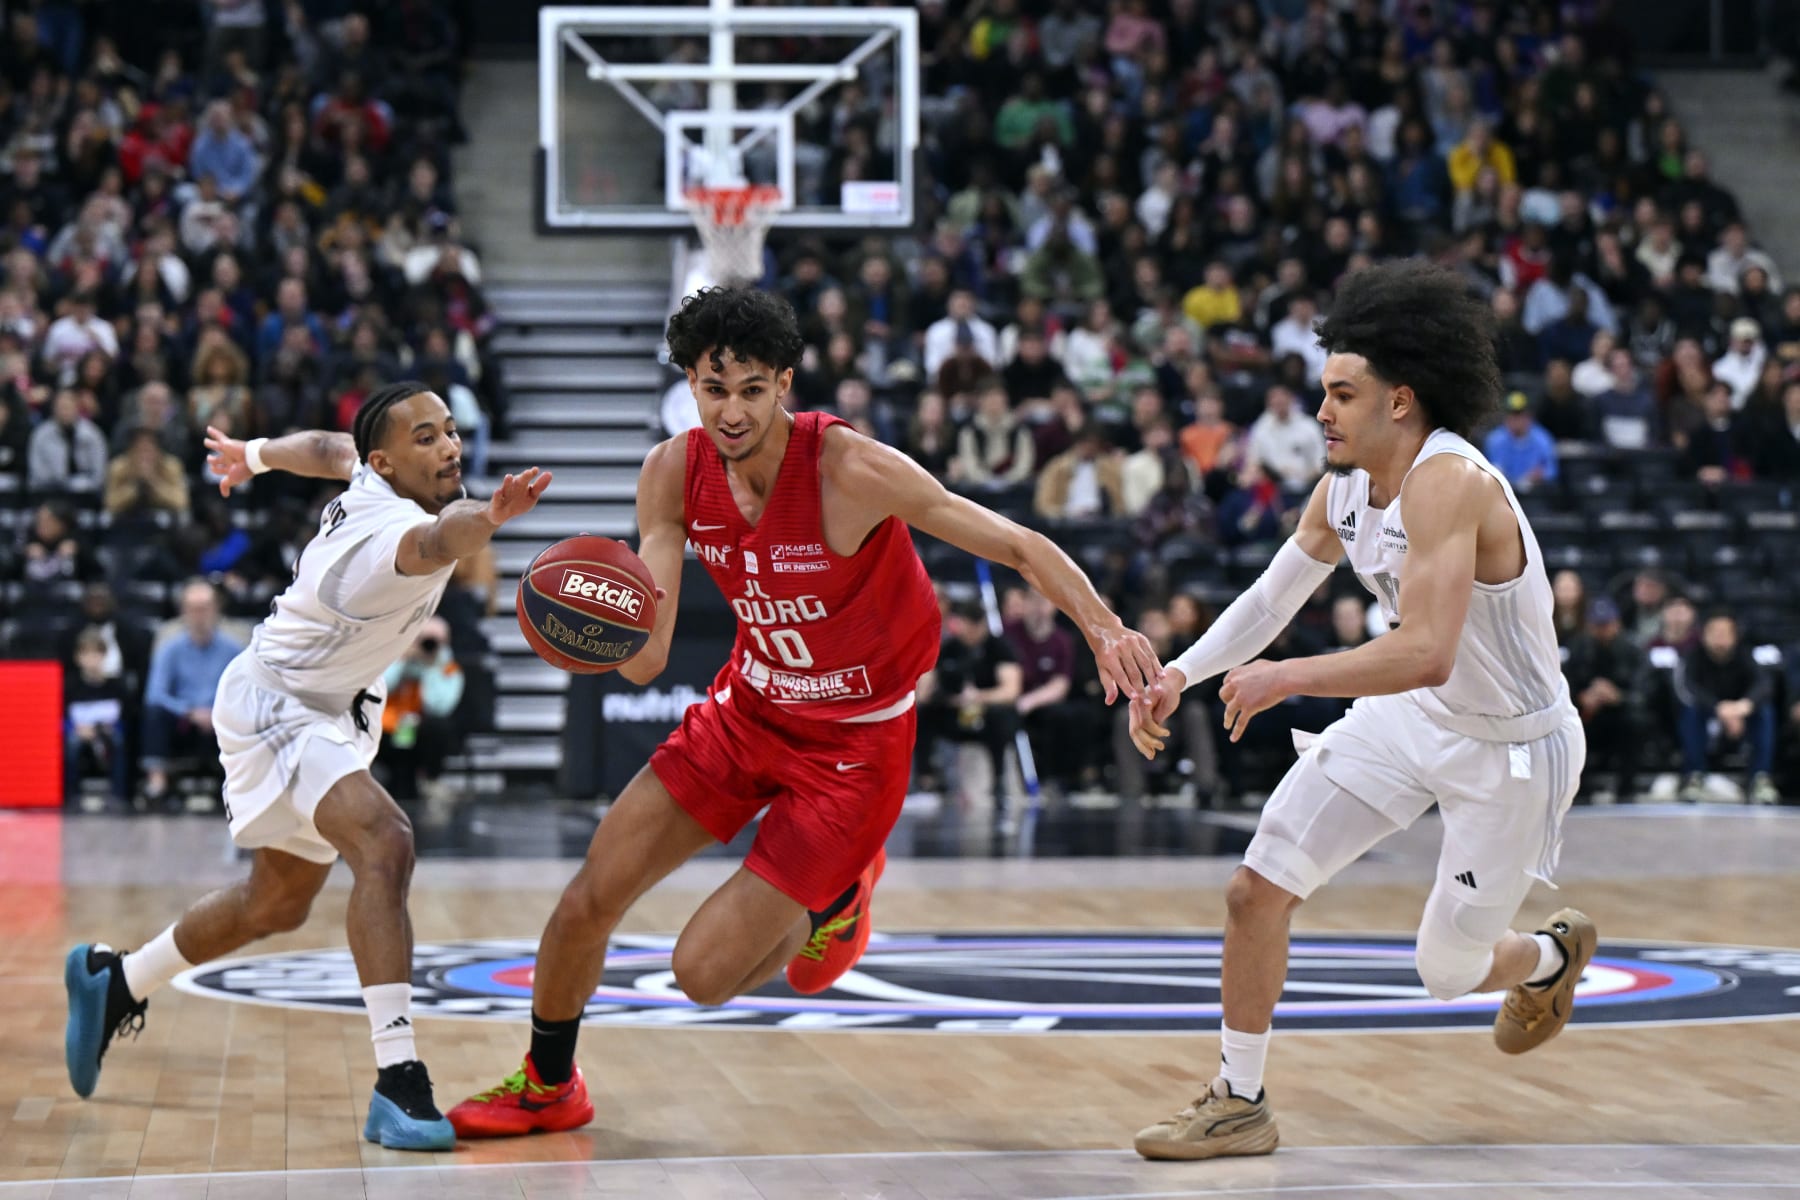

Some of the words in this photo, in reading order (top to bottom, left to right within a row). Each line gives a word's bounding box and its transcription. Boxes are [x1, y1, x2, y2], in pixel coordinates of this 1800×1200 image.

[785, 543, 823, 552] KAPEC
[563, 573, 641, 614] Betclic
[541, 612, 633, 658] SPALDING
[749, 627, 814, 668] 10
[771, 673, 845, 692] BRASSERIE
